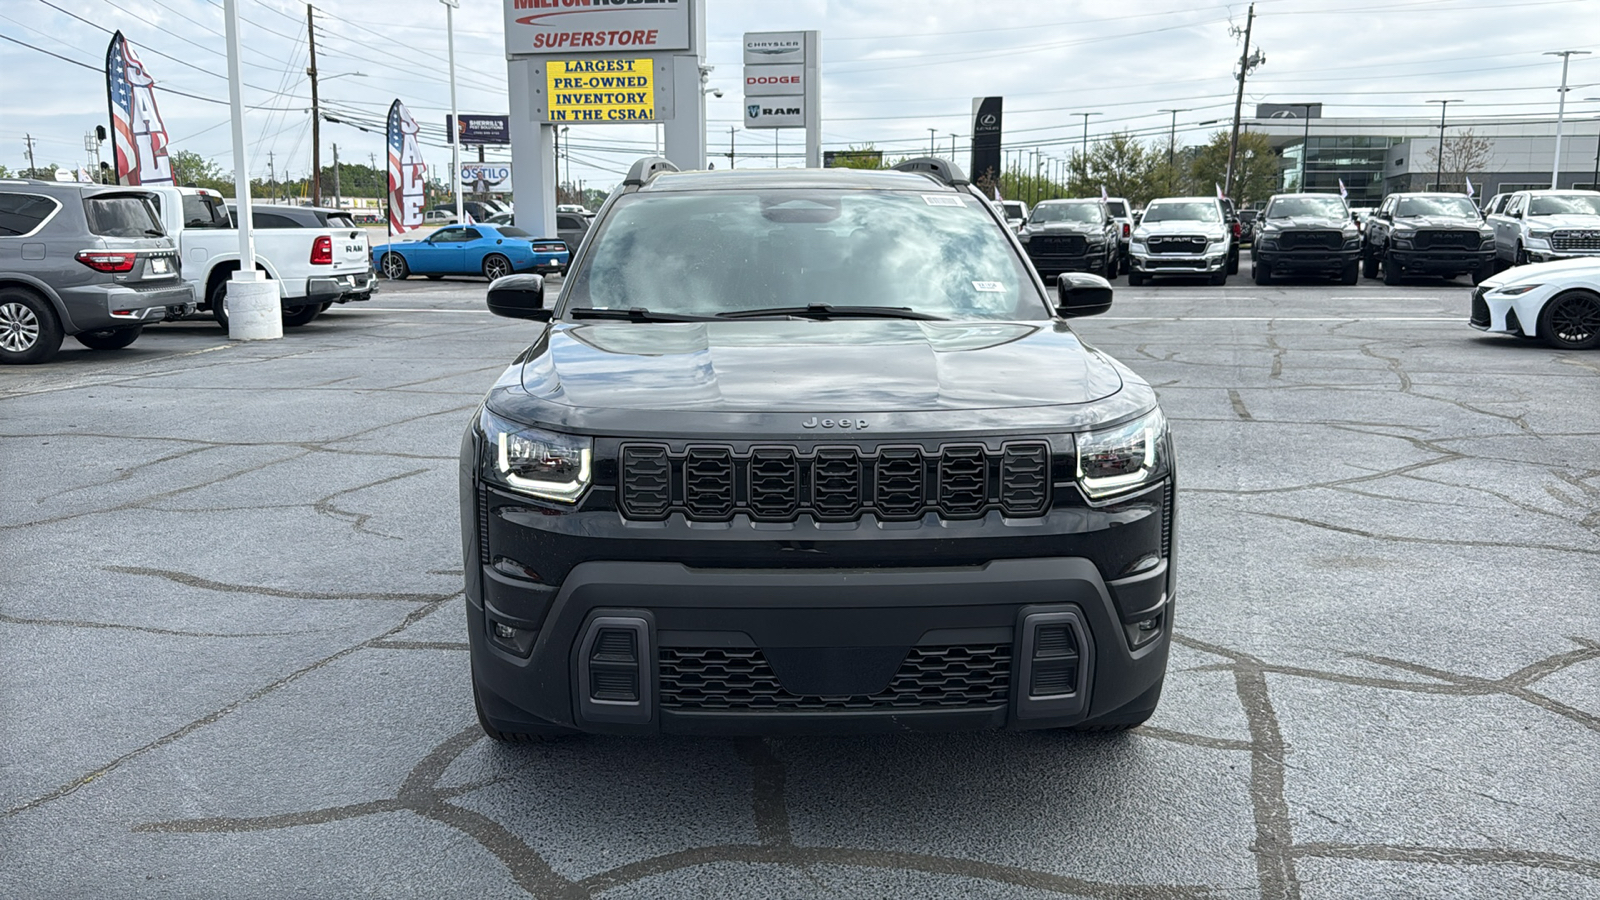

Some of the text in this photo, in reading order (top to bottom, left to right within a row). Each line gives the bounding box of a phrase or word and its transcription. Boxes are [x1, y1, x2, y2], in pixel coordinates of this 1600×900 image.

[533, 29, 659, 48] SUPERSTORE
[565, 60, 635, 73] LARGEST
[554, 76, 648, 89] PRE-OWNED
[746, 76, 800, 85] DODGE
[556, 92, 647, 105] INVENTORY
[550, 108, 653, 121] IN THE CSRA!
[762, 108, 800, 116] RAM
[345, 245, 363, 253] RAM
[802, 416, 869, 430] Jeep
